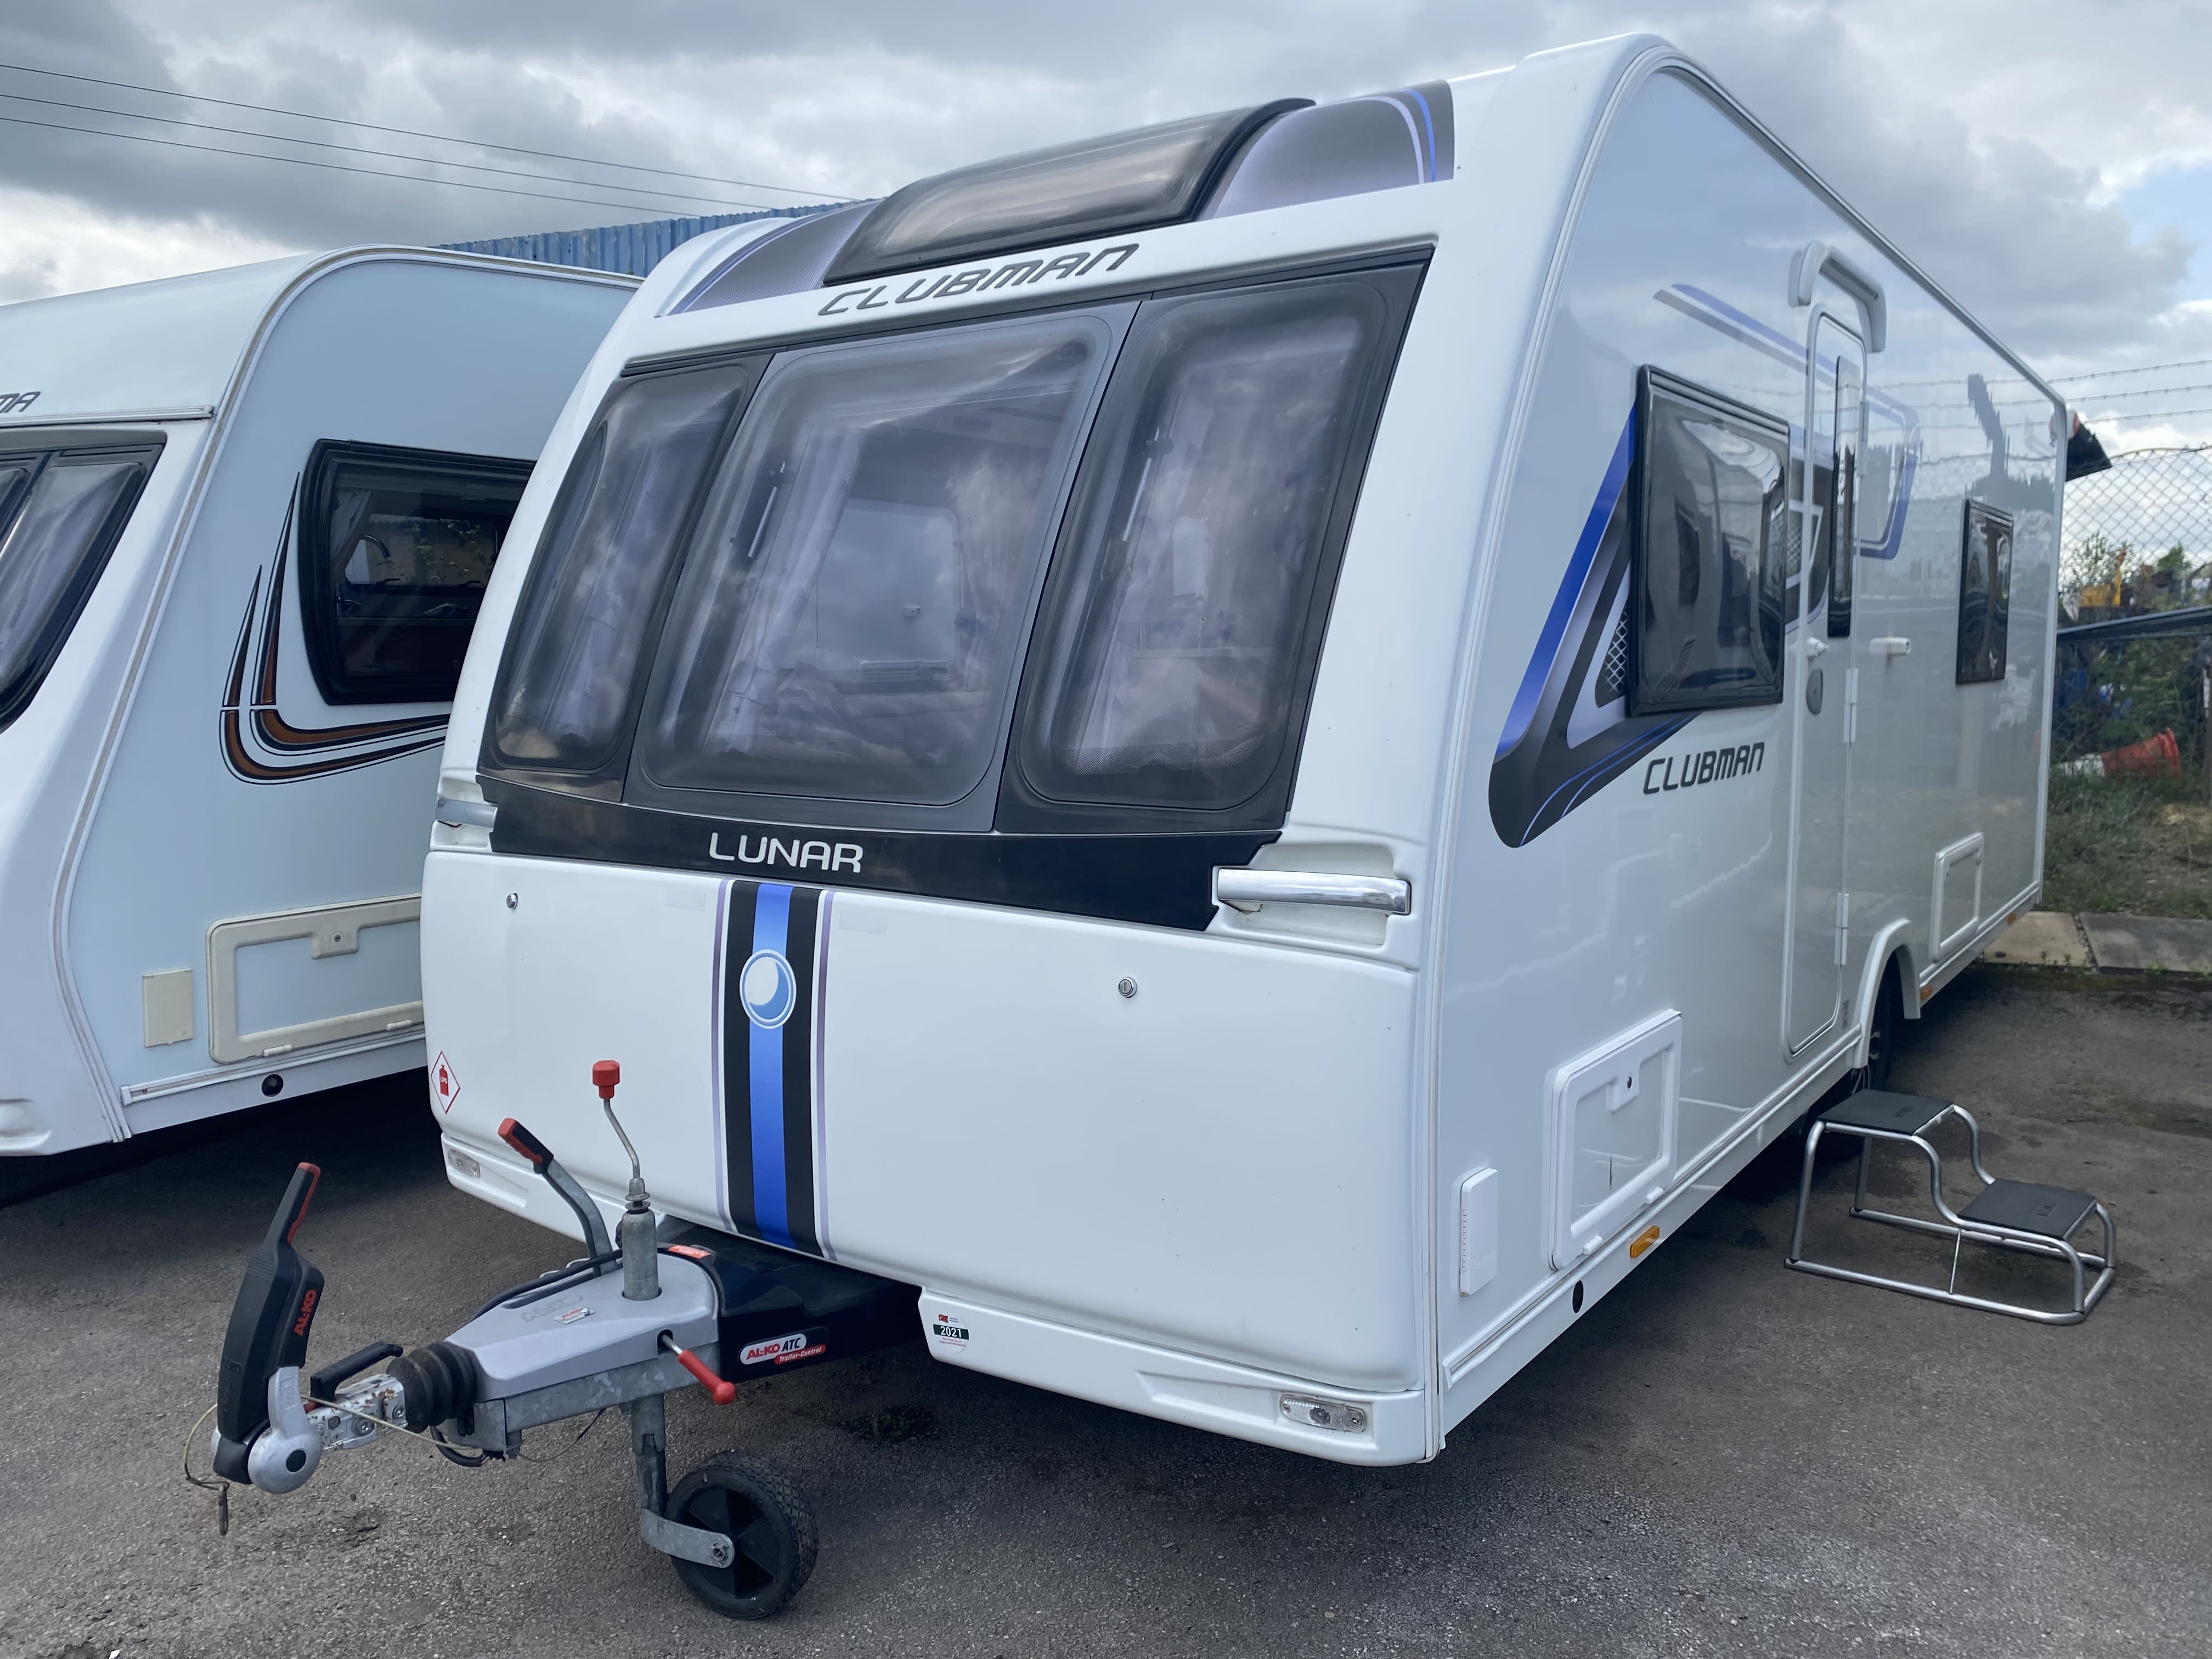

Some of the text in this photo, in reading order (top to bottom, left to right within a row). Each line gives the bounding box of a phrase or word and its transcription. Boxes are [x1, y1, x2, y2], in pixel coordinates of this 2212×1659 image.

[817, 243, 1141, 316] CLUBMAN
[1643, 741, 1765, 795] CLUBMAN
[709, 832, 864, 873] LUNAR
[294, 1289, 317, 1336] AL-KO
[940, 1325, 962, 1339] 2021
[746, 1337, 801, 1360] AL-KO ATC
[779, 1346, 822, 1363] Trailer-Control
